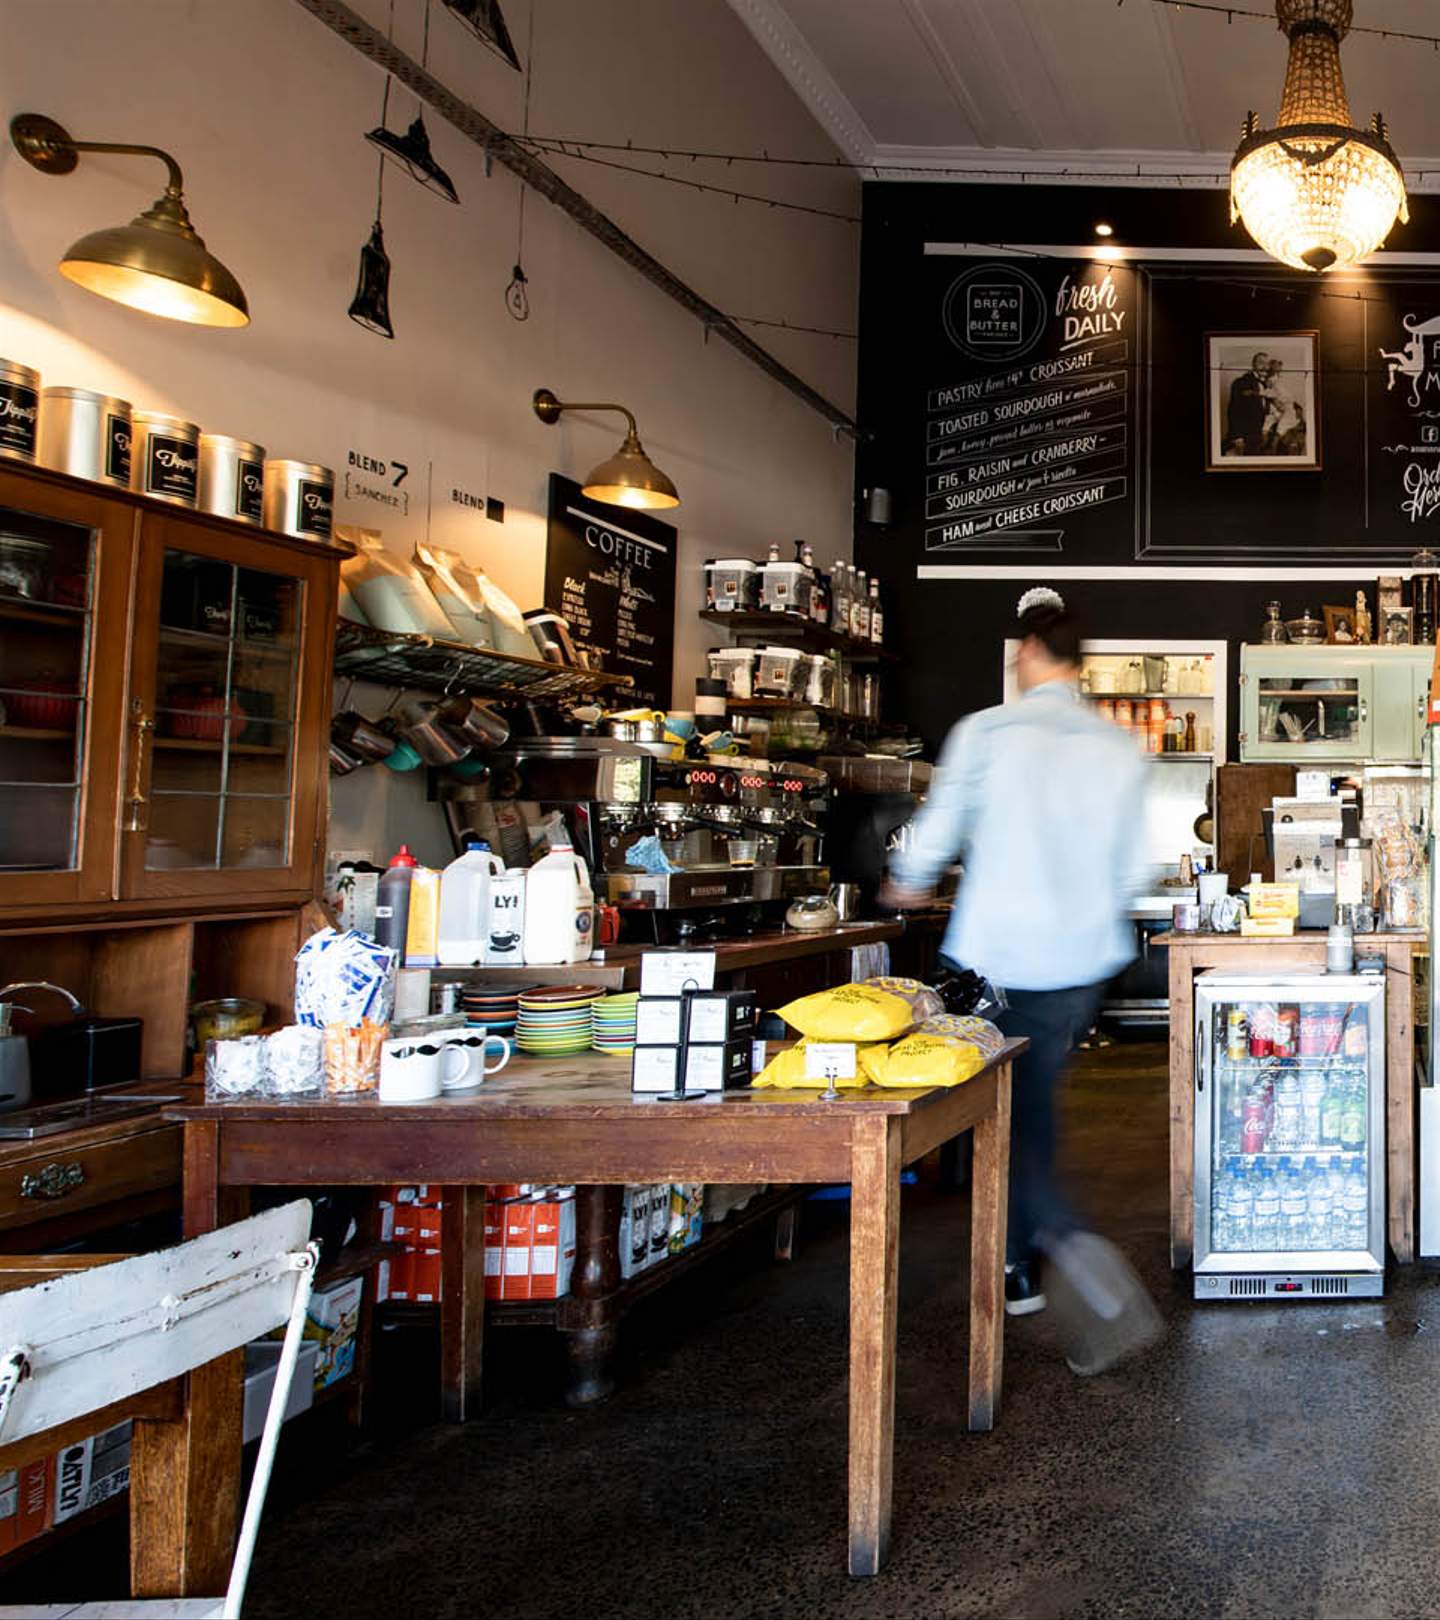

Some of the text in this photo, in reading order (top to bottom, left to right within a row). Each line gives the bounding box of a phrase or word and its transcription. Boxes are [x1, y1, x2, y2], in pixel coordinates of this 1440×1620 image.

[973, 299, 1018, 309] BREAD
[1055, 274, 1118, 317] fresh
[970, 322, 1018, 332] BUTTER
[1064, 311, 1126, 342] DAILY
[938, 383, 983, 406] PASTRY
[1029, 352, 1093, 381] CROISSANT
[937, 410, 989, 436] TOASTED
[993, 391, 1063, 420] SOURDOUGH
[348, 450, 409, 487] BLEND 7
[967, 458, 1011, 482] RAISIN
[1031, 435, 1098, 465] CRANBERRY
[452, 488, 485, 511] BLEND
[942, 522, 975, 542] HAM
[995, 503, 1041, 527] CHEESE
[1043, 485, 1105, 513] CROISSANT
[944, 480, 1016, 511] SOURDOUGH
[585, 525, 652, 570] COFFEE
[60, 1447, 84, 1511] OATLY!
